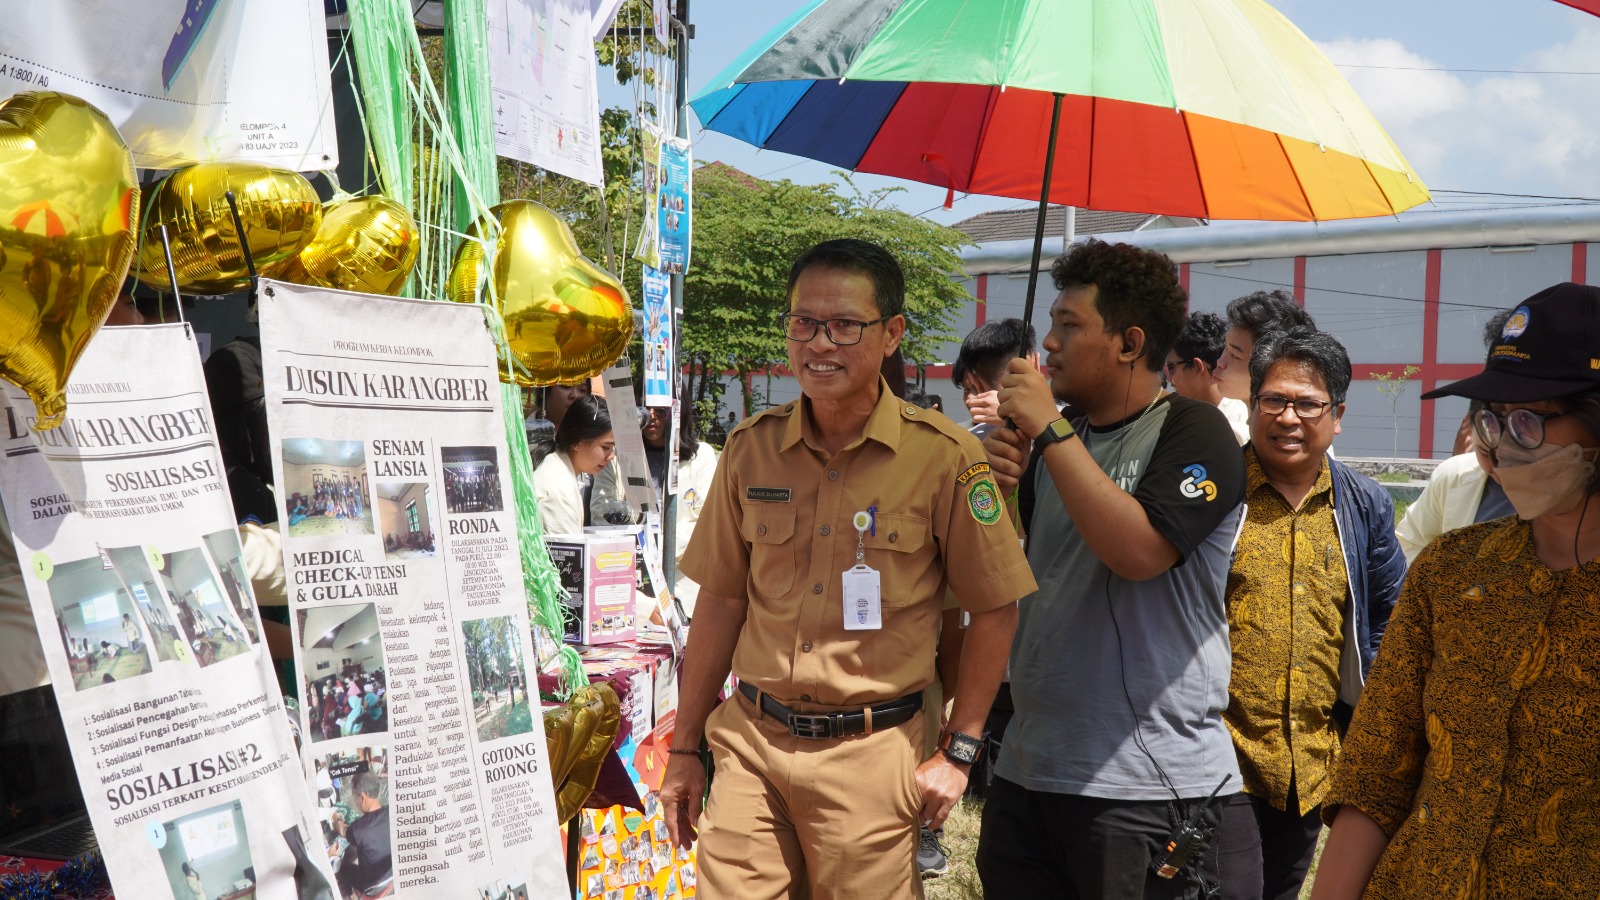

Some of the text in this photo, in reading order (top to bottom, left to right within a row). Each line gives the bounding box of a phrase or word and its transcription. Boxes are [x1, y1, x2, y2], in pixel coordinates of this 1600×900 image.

[10, 66, 32, 84] 1:800
[333, 340, 434, 358] PROGRAM KERJA KELOMPOK
[285, 365, 490, 402] DUSUN KARANGBER
[372, 439, 426, 456] SENAM
[106, 459, 216, 492] SOSIALISASI
[374, 460, 428, 477] LANSIA
[182, 488, 200, 498] DAN
[32, 504, 72, 520] DALAM
[161, 500, 184, 512] UMKM
[448, 518, 500, 535] RONDA
[293, 549, 364, 567] MEDICAL
[39, 562, 44, 570] 1
[294, 564, 407, 585] CHECK-UP TENSI
[296, 582, 398, 602] & GULA DARAH
[484, 582, 506, 590] RONDA
[409, 613, 438, 625] kelompok
[442, 612, 446, 620] 4
[434, 637, 450, 648] yang
[429, 649, 451, 660] dengan
[426, 661, 453, 672] Pajangan
[390, 680, 402, 689] dan
[423, 672, 455, 684] melakukan
[436, 684, 456, 696] Tujuan
[91, 705, 132, 724] Sosialisasi
[134, 693, 179, 712] Bangunan
[393, 704, 408, 714] dari
[441, 707, 460, 718] adalah
[96, 721, 135, 739] Sosialisasi
[137, 706, 190, 726] Pencegahan
[100, 735, 138, 753] Sosialisasi
[140, 724, 170, 741] Fungsi
[172, 717, 199, 732] Design
[105, 749, 143, 768] Sosialisasi
[144, 732, 203, 754] Pemanfaatan
[232, 712, 261, 730] Business
[394, 728, 417, 740] untuk
[394, 741, 421, 752] sarana
[482, 742, 536, 766] GOTONG
[101, 763, 143, 785] Media Sosial
[106, 742, 262, 811] SOSIALISASI #2
[395, 765, 423, 777] untuk
[485, 759, 538, 784] ROYONG
[396, 775, 437, 789] kesehatan
[396, 788, 437, 802] terutama
[114, 803, 161, 828] SOSIALISASI
[163, 788, 206, 810] TERKAIT
[396, 802, 426, 814] lanjut
[396, 811, 446, 826] Sedangkan
[154, 829, 159, 838] 1
[397, 828, 427, 839] lansia
[398, 837, 438, 851] mengisi
[398, 852, 428, 863] lansia
[399, 860, 450, 876] mengasah
[400, 876, 440, 889] mereka.
